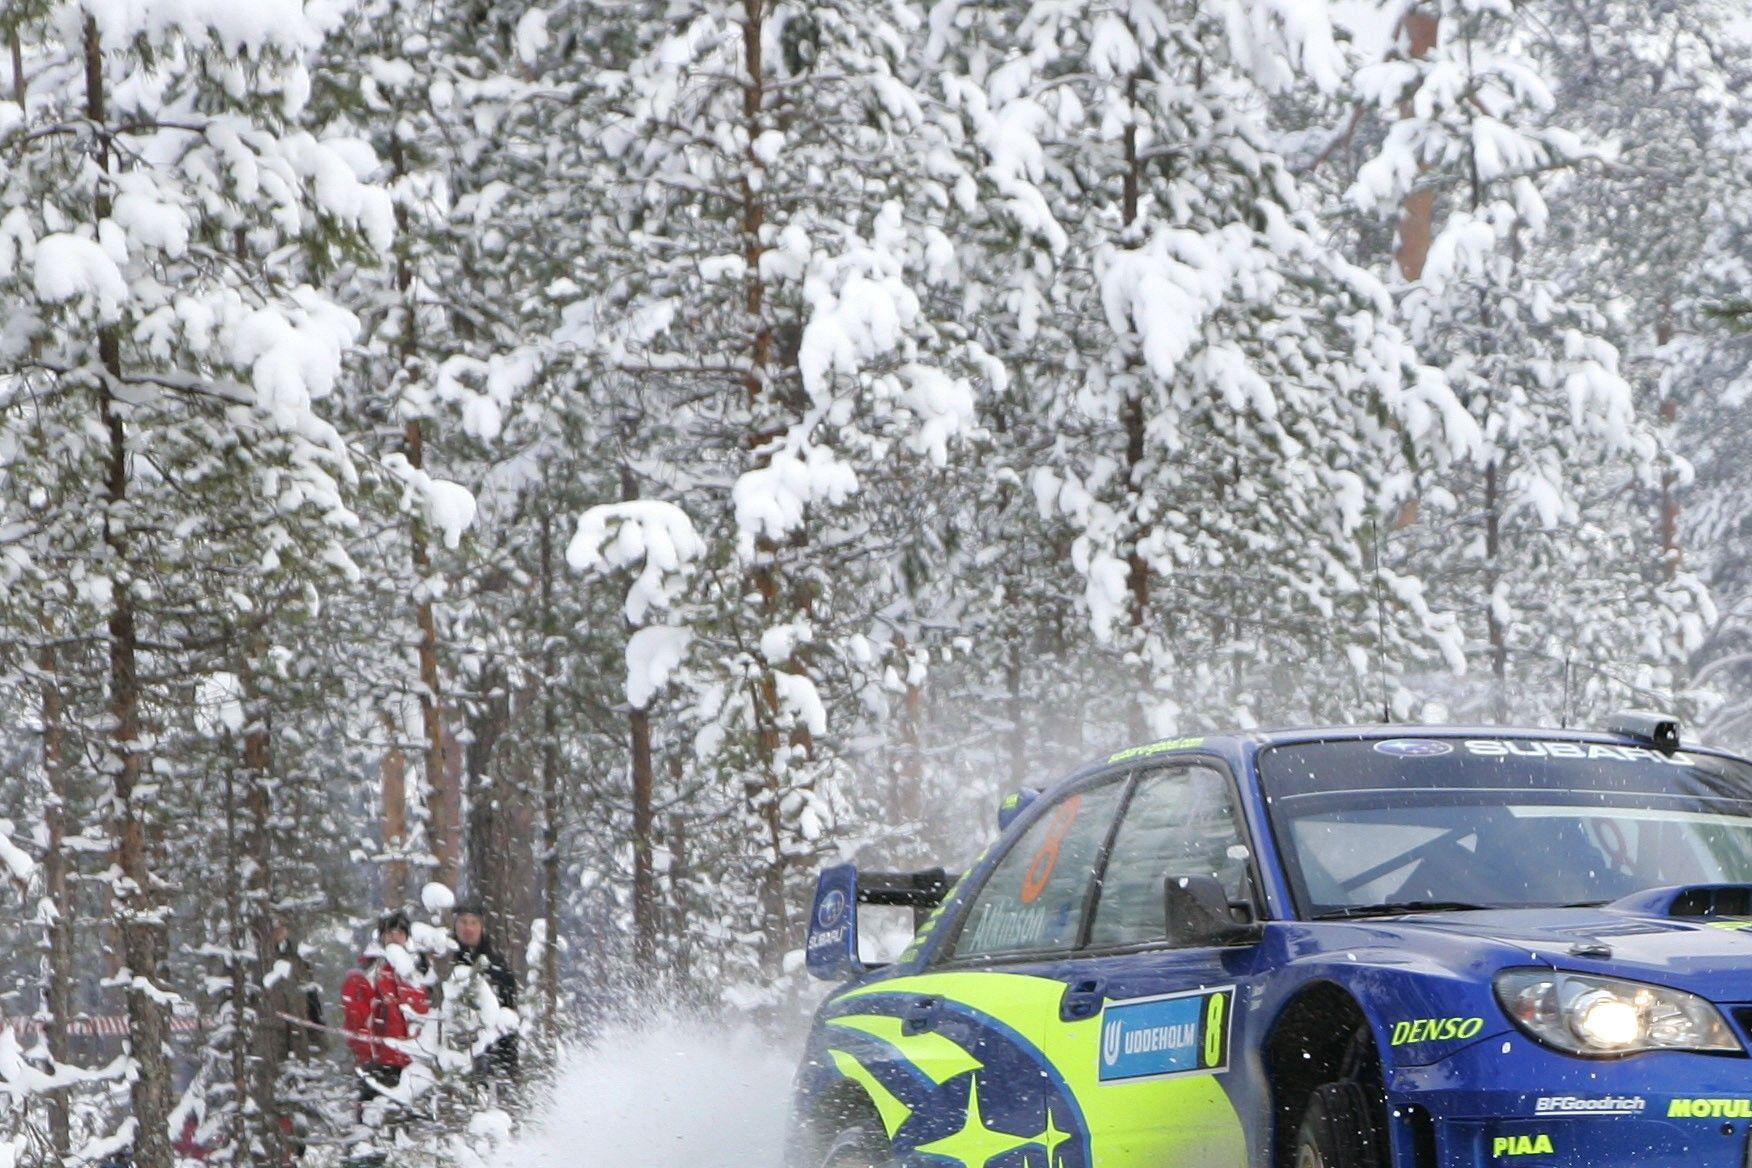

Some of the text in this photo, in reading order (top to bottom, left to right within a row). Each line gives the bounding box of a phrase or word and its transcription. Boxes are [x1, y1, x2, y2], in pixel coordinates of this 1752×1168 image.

[1464, 740, 1695, 766] SUBARU
[1019, 794, 1083, 904] 8
[1124, 1023, 1195, 1055] UDDEHOLM
[1205, 992, 1224, 1067] 8
[1391, 1017, 1483, 1046] DENSO
[1536, 1096, 1646, 1111] BFGoodrich
[1667, 1099, 1752, 1117] MOTUL
[1493, 1135, 1554, 1156] PIAA
